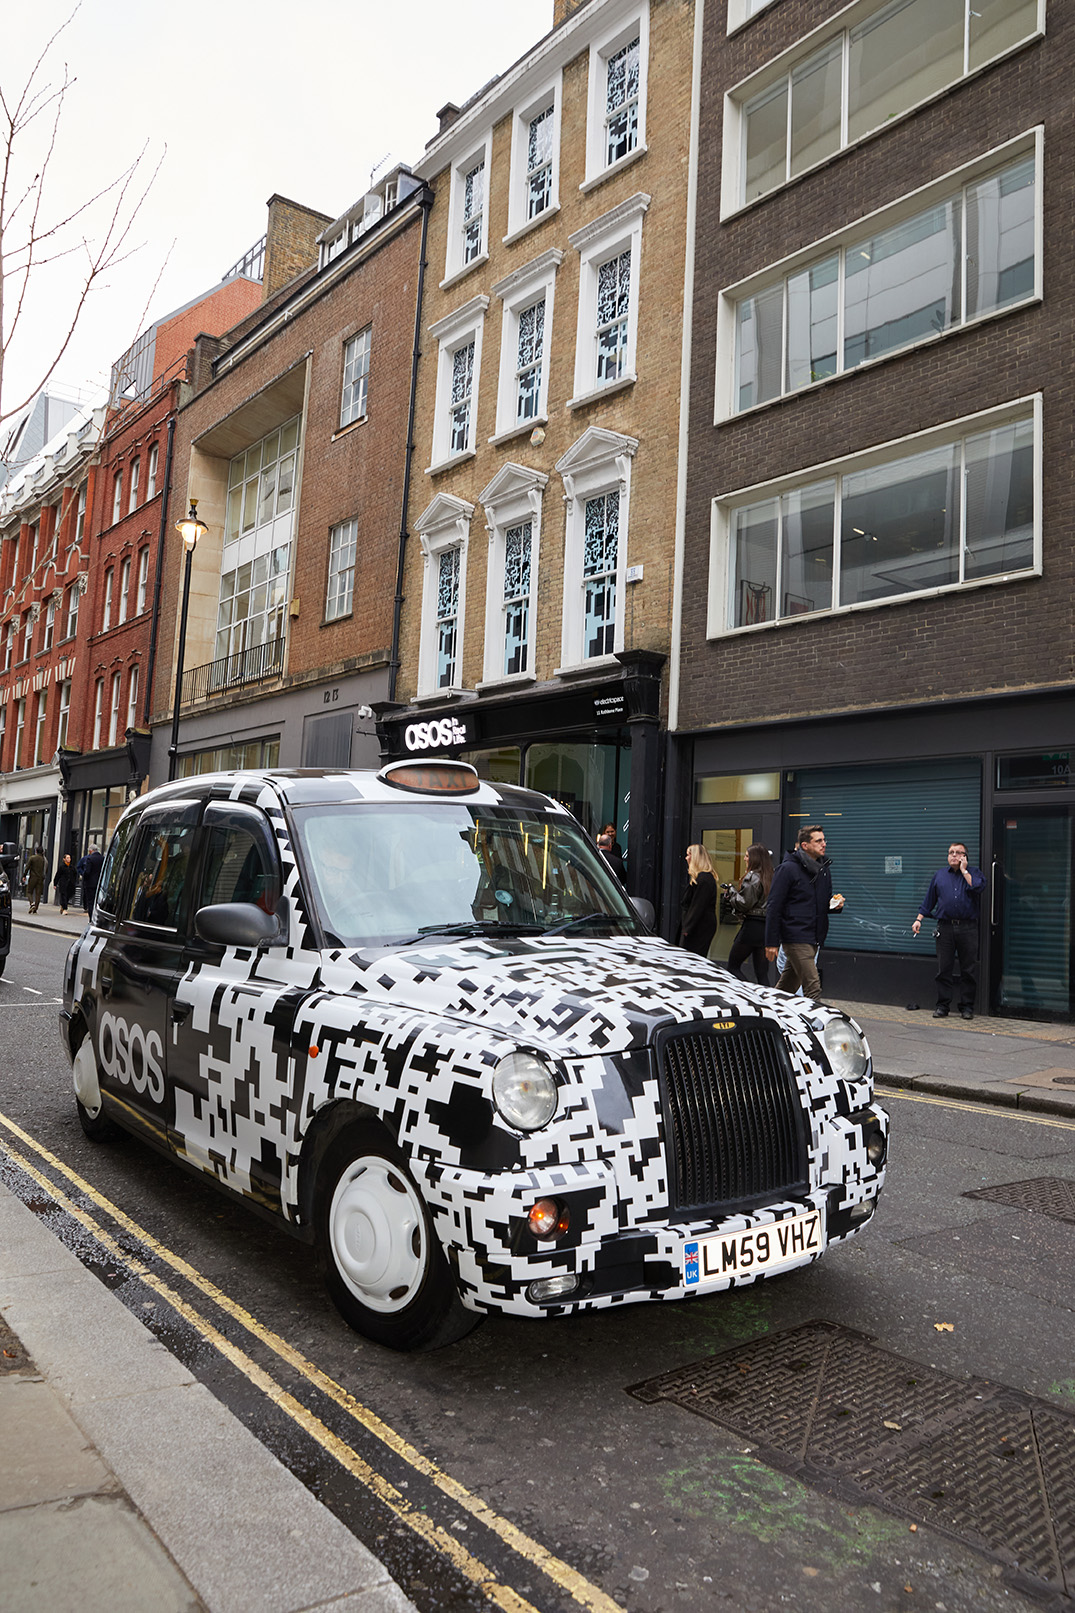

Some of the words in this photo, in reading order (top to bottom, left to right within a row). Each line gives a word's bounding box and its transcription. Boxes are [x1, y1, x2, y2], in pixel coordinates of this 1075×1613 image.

[1051, 765, 1072, 775] 10A
[414, 769, 466, 788] TAXI
[702, 1231, 771, 1277] LM59
[777, 1215, 819, 1257] VHZ
[686, 1269, 698, 1280] UK
